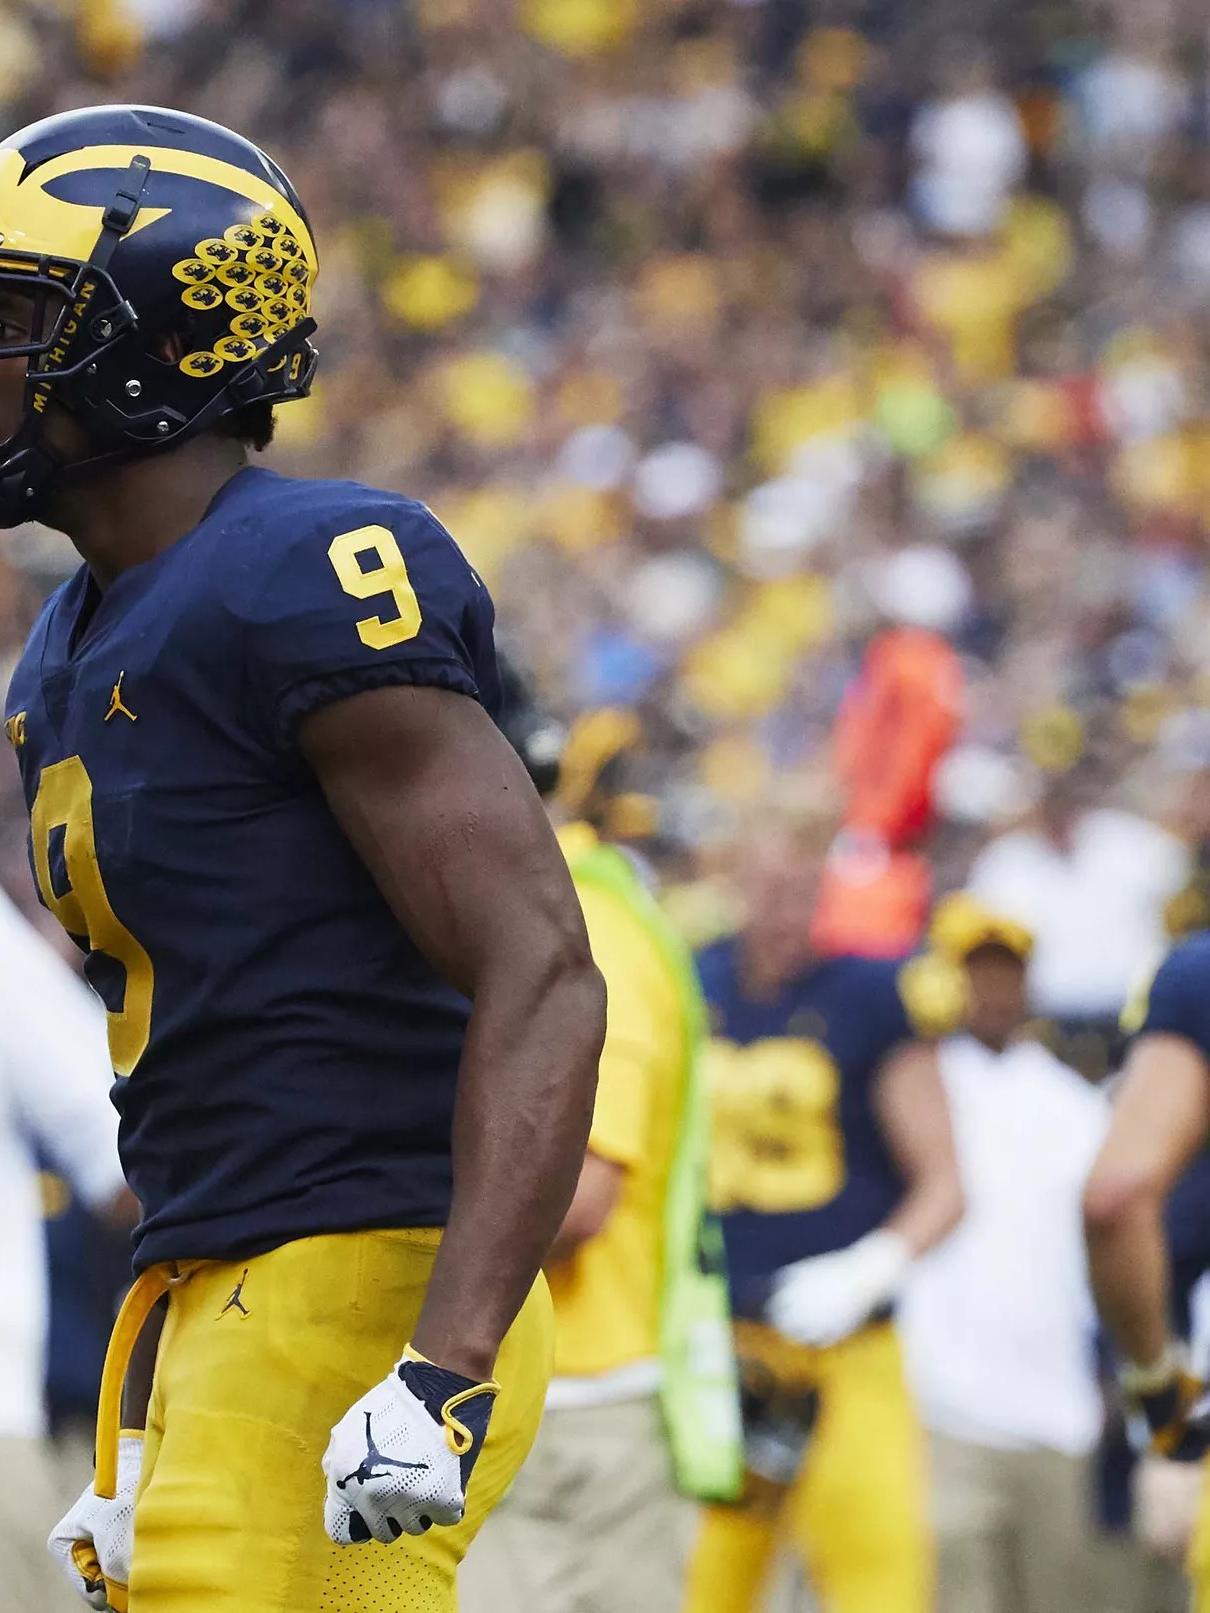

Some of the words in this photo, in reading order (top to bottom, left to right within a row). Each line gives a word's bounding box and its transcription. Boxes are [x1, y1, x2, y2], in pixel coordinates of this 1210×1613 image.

[289, 353, 302, 380] 9
[328, 524, 423, 650] 9
[31, 754, 154, 1078] 9
